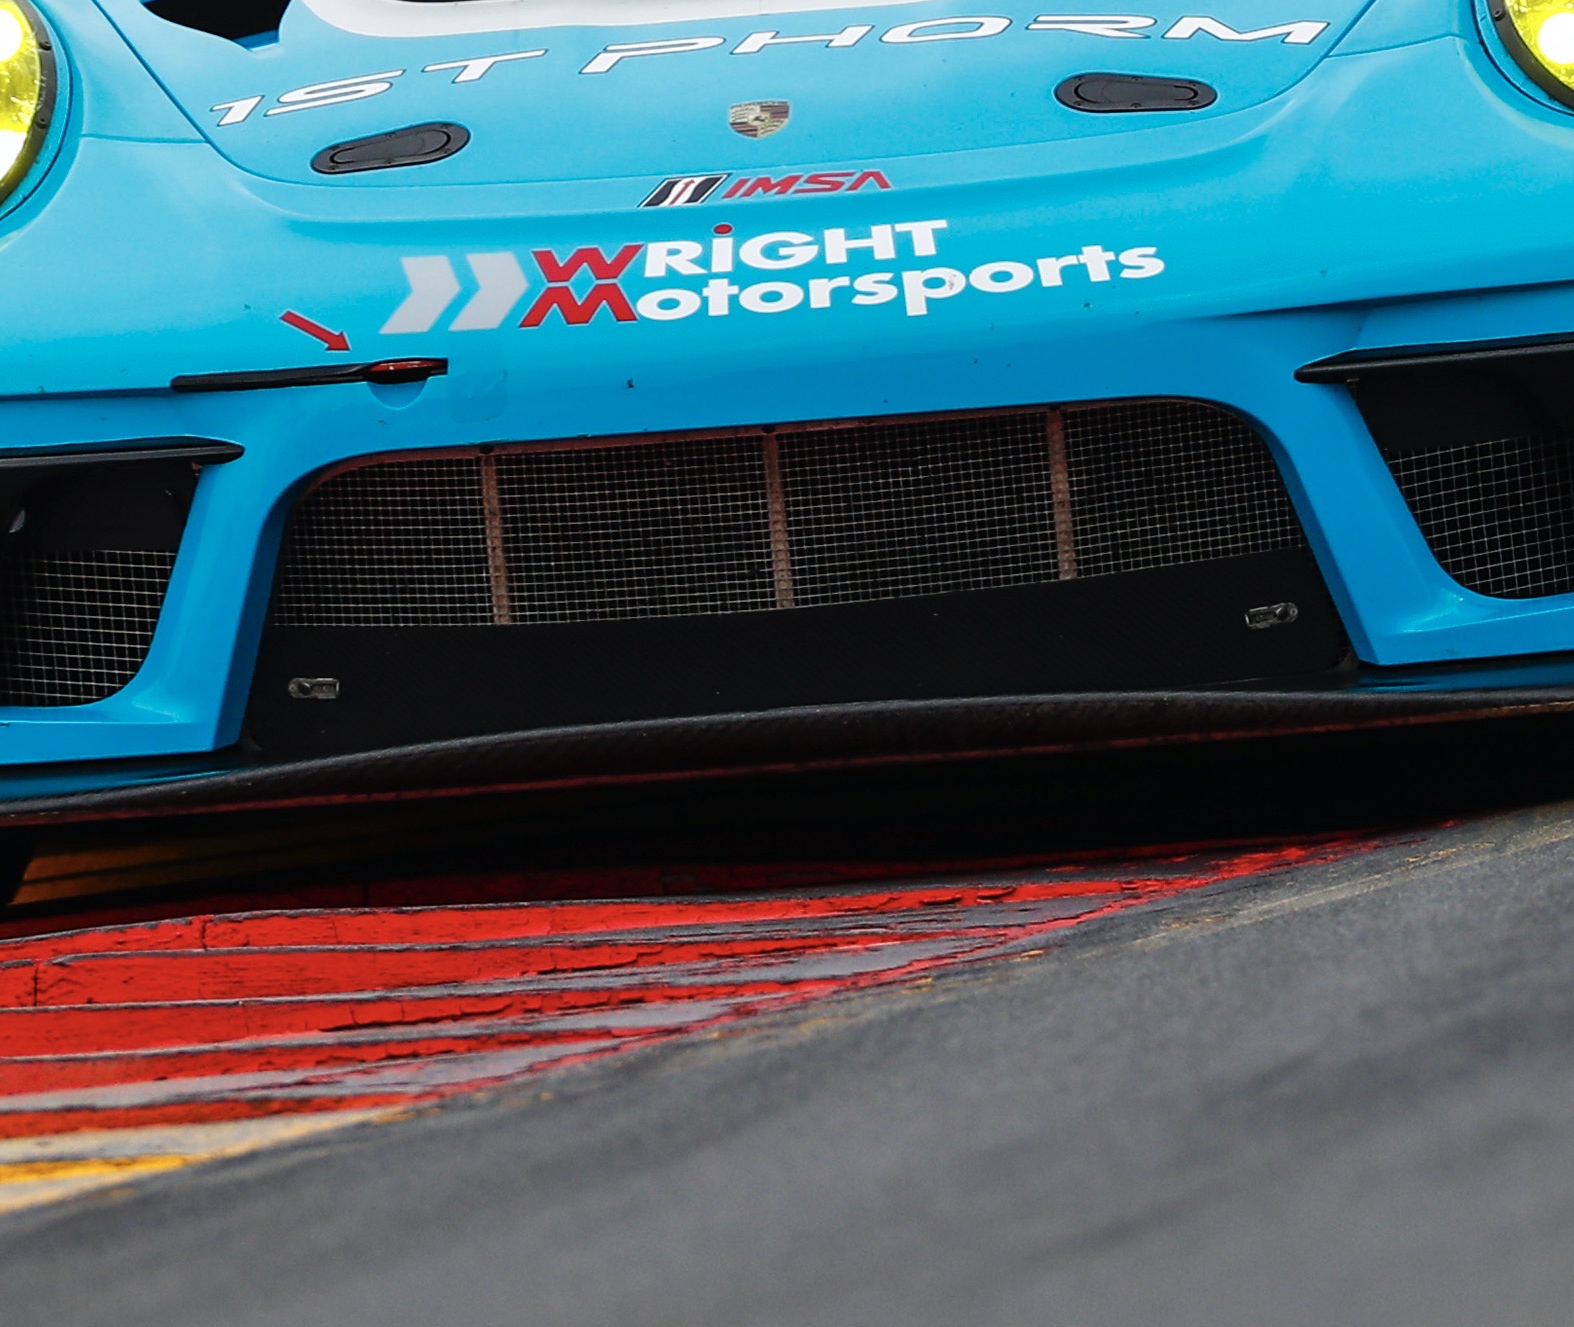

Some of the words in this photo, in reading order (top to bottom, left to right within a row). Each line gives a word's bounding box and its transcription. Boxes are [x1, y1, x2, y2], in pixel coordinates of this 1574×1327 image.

[210, 48, 549, 127] 1ST
[578, 14, 1332, 75] PHORM
[723, 171, 893, 200] IMSA
[519, 244, 1166, 328] Motorsports
